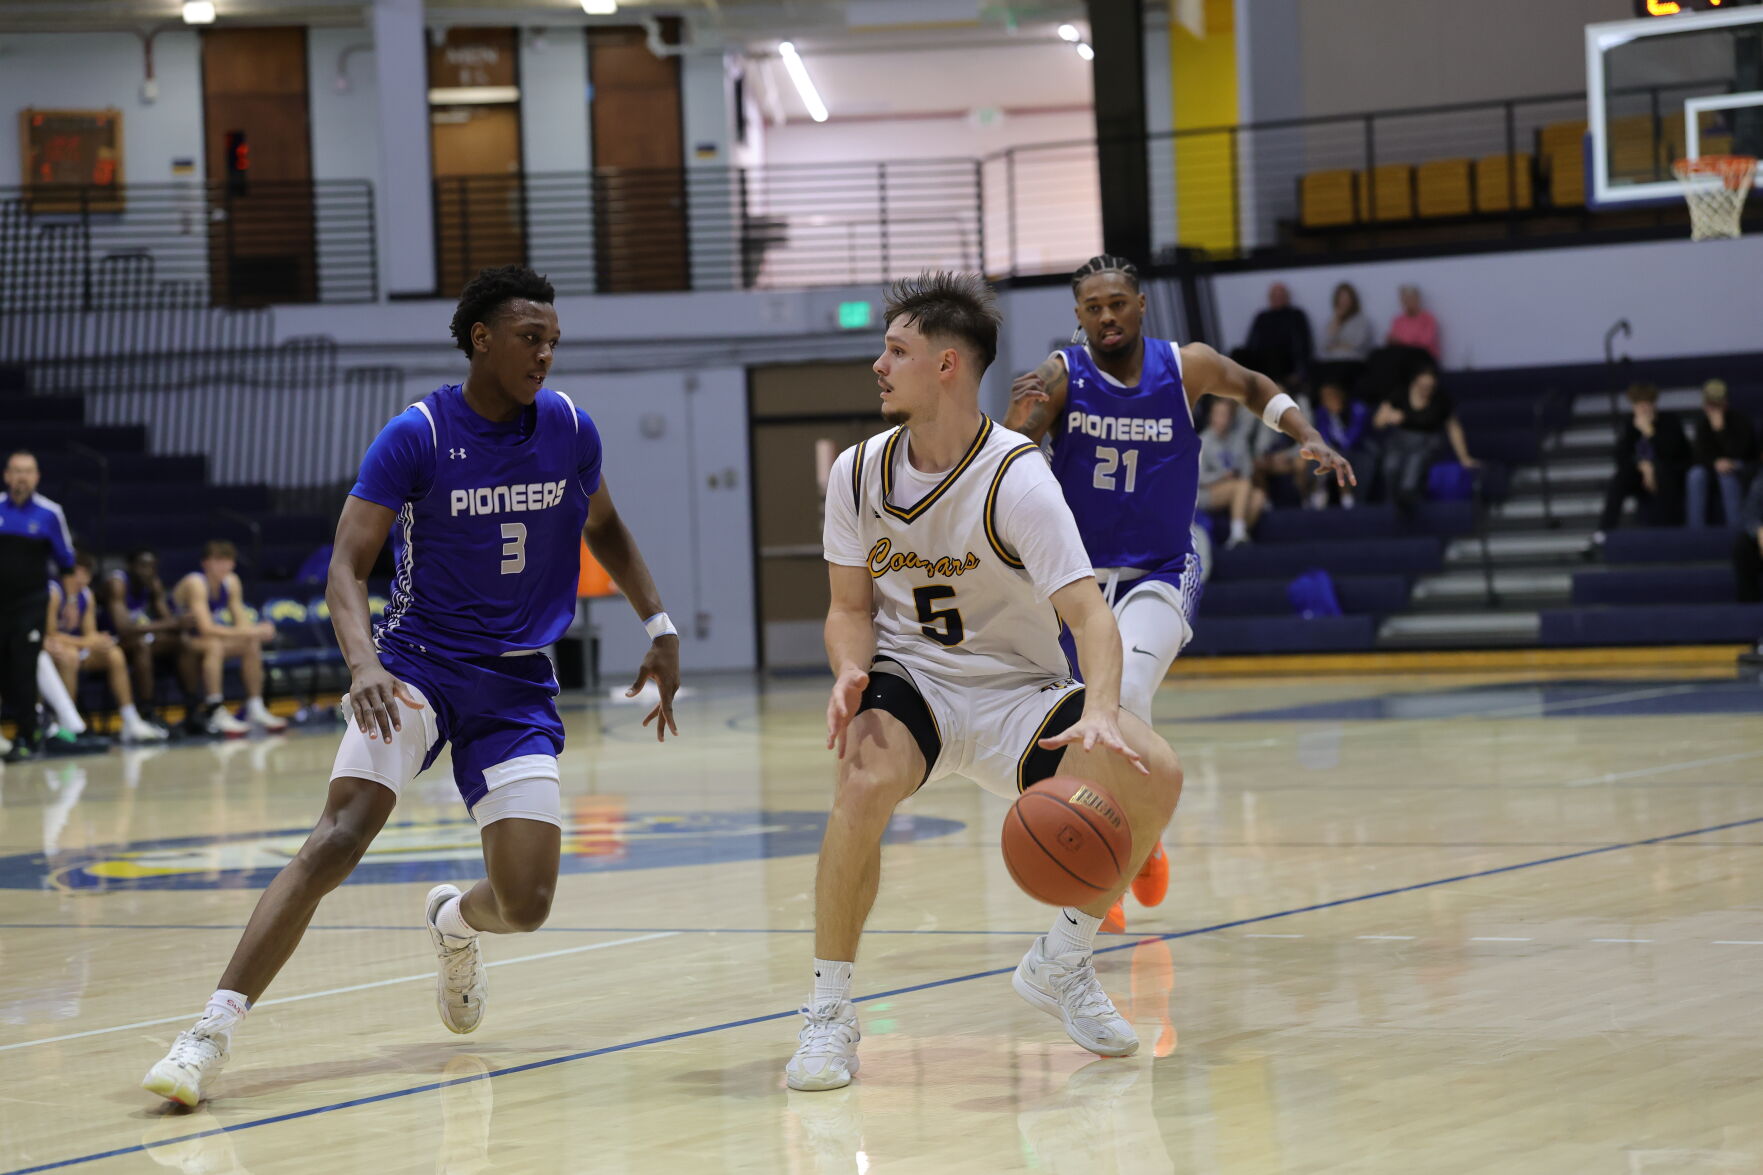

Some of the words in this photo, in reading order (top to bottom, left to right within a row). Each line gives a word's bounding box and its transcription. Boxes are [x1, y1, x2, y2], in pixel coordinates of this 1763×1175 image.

[1068, 411, 1173, 442] PIONEERS
[1093, 445, 1139, 493] 21
[450, 478, 567, 517] PIONEERS
[500, 522, 528, 575] 3
[912, 583, 966, 647] 5
